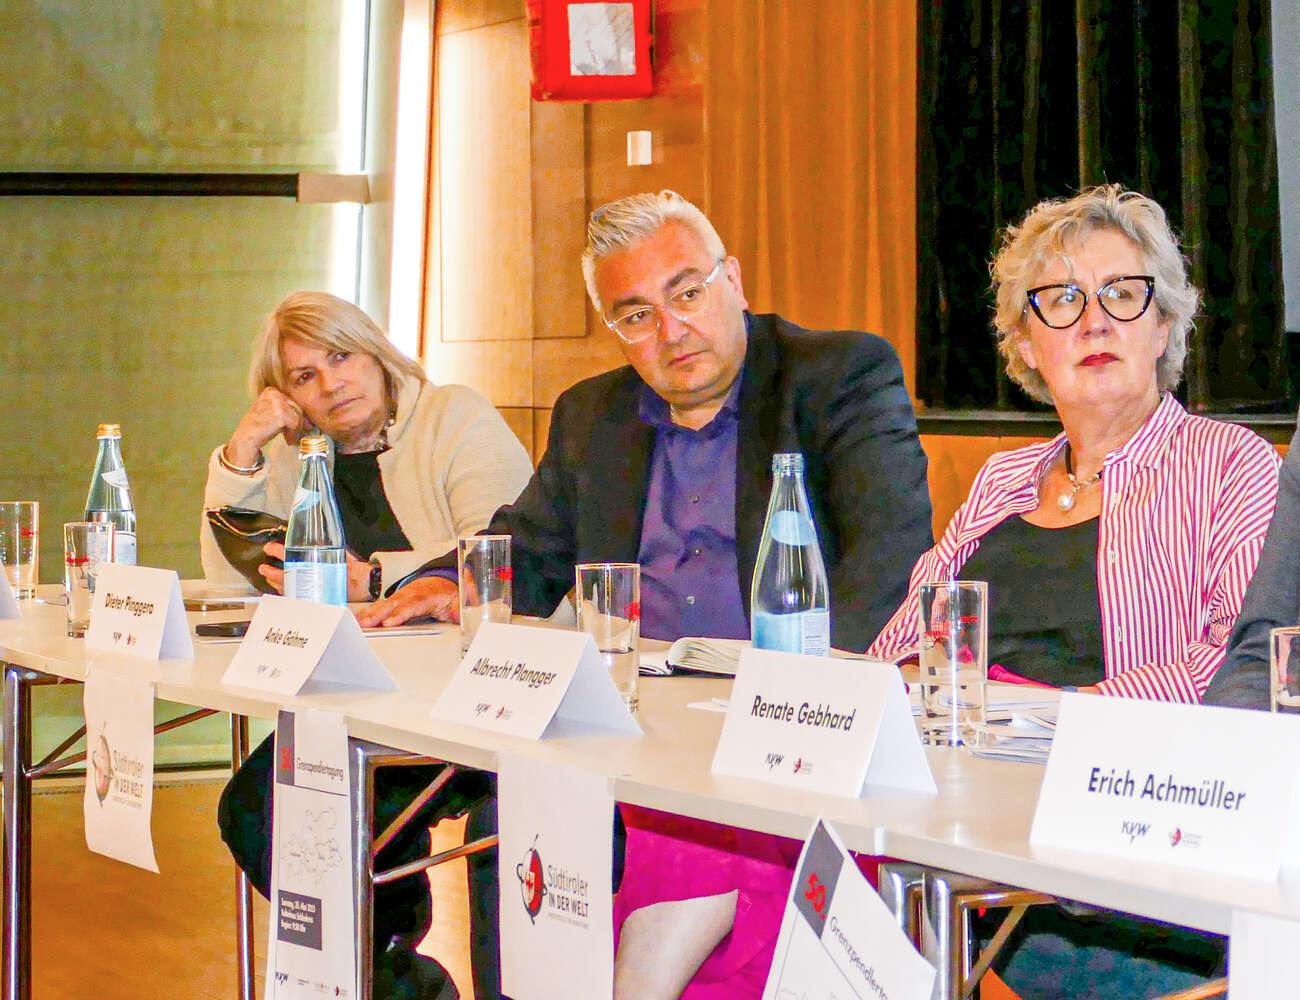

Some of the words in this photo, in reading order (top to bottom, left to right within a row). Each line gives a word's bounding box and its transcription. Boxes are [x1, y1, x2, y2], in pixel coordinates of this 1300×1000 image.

[105, 593, 124, 610] Dieter
[470, 658, 513, 681] Albrecht
[510, 663, 557, 689] Plangger
[751, 695, 794, 722] Renate
[797, 702, 856, 731] Gebhard
[1087, 767, 1135, 798] Erich
[1140, 773, 1246, 811] Achmüller
[547, 865, 588, 897] Südtiroler
[556, 894, 570, 912] DER
[571, 898, 589, 918] WELT
